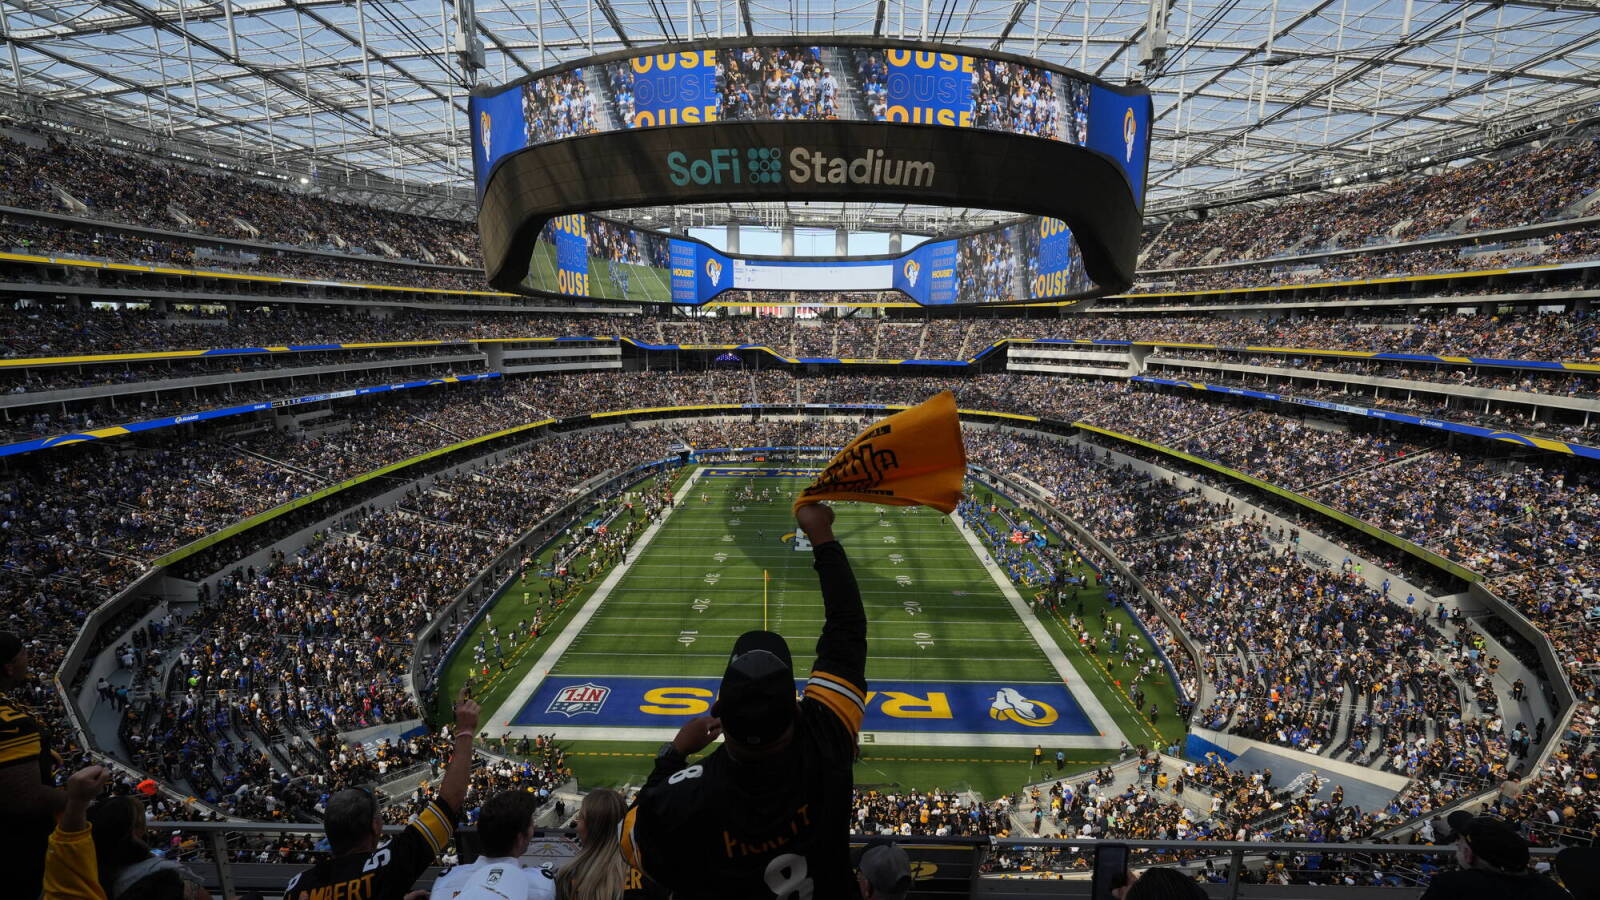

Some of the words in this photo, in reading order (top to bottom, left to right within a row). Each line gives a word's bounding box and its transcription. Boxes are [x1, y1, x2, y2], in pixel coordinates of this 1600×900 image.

[667, 148, 741, 186] SoFi
[789, 147, 936, 187] Stadium
[565, 687, 605, 702] NFL
[667, 764, 703, 785] 8
